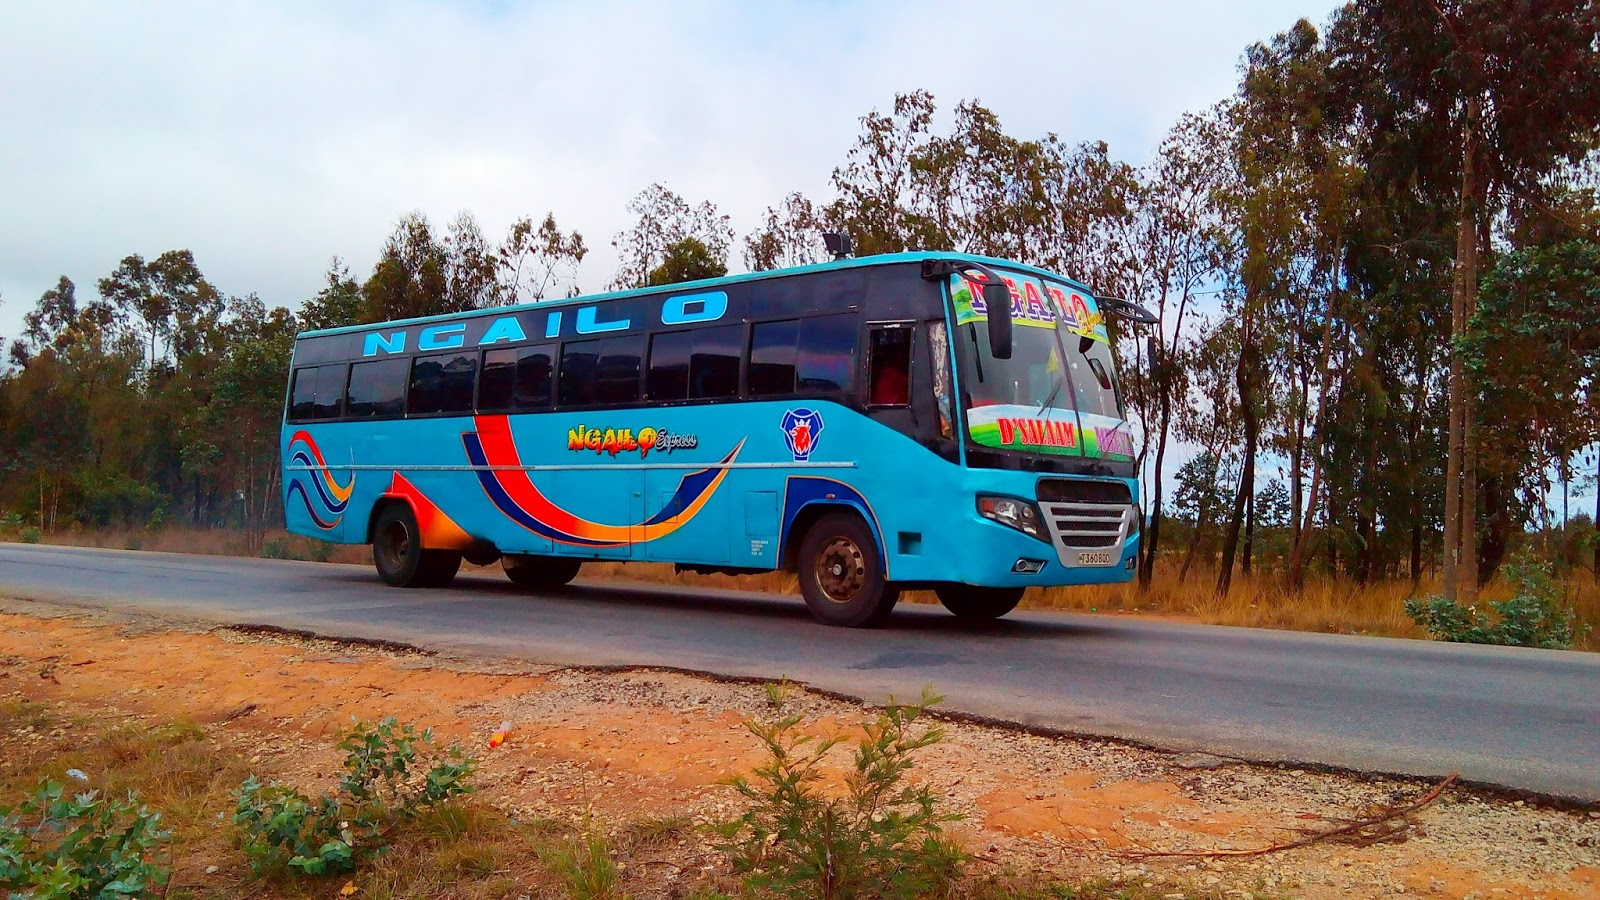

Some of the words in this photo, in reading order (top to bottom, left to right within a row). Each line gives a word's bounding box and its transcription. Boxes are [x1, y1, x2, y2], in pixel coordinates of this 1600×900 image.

[363, 291, 727, 357] NGAILO
[568, 424, 657, 458] NGAILO
[655, 427, 697, 454] Express
[997, 417, 1076, 448] D'SALAAM
